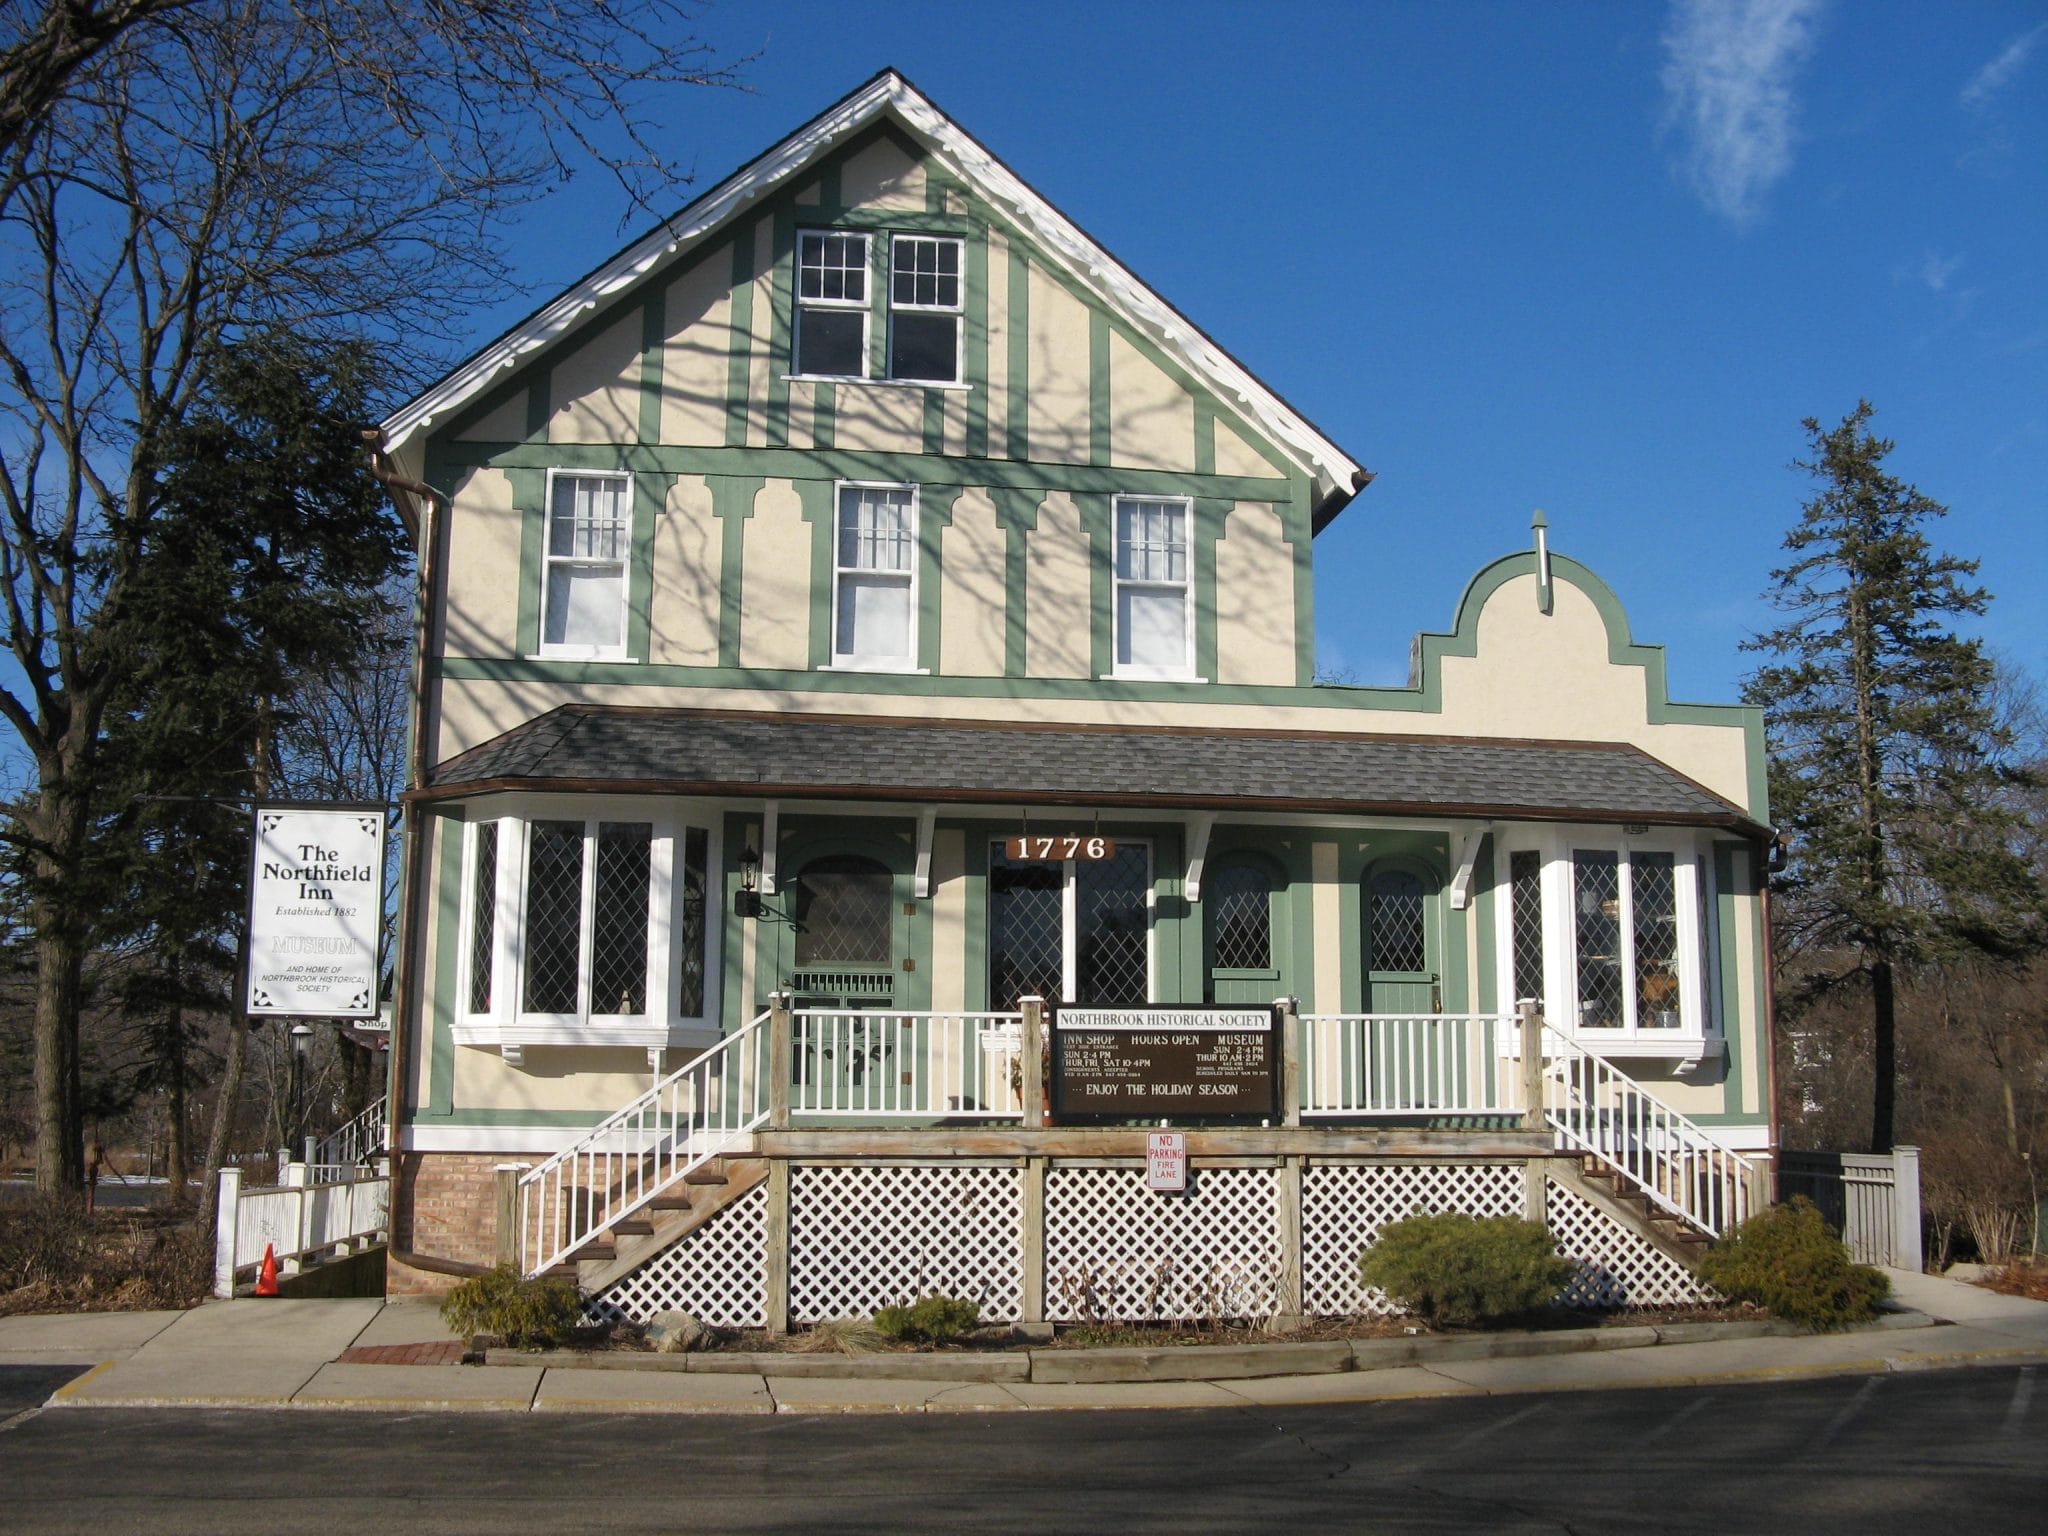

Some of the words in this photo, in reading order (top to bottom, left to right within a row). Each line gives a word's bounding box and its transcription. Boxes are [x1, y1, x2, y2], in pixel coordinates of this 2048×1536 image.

[298, 844, 339, 861] The
[1018, 837, 1105, 859] 1776
[263, 863, 371, 881] Northfield
[299, 883, 334, 900] Inn
[275, 906, 331, 916] Established
[334, 907, 356, 917] 1882
[272, 936, 356, 955] MUSEUM
[261, 974, 318, 983] NORTHBROOK
[319, 975, 366, 984] HISTORICAL
[296, 984, 331, 993] SOCIETY
[1061, 1013, 1144, 1025] NORTHBROOK
[1147, 1014, 1216, 1026] HISTORICAL
[1219, 1015, 1266, 1026] SOCIETY
[1063, 1034, 1082, 1045] INN
[1086, 1034, 1115, 1045] SHOP
[1131, 1035, 1168, 1045] HOURS
[1171, 1034, 1200, 1045] OPEN
[1217, 1034, 1264, 1046] MUSEUM
[1063, 1051, 1080, 1059] SUN
[1099, 1051, 1111, 1059] PM
[1213, 1046, 1230, 1054] SUN
[1252, 1046, 1264, 1054] PM
[1103, 1059, 1120, 1067] SAT
[1196, 1054, 1218, 1062] THUR
[1252, 1054, 1264, 1062] PM
[1086, 1084, 1119, 1095] ENJOY
[1125, 1084, 1147, 1095] THE
[1151, 1084, 1194, 1096] HOLIDAY
[1198, 1084, 1239, 1095] SEASON
[1159, 1135, 1173, 1146] NO
[1149, 1148, 1184, 1160] PARKING
[1157, 1161, 1176, 1169] FIRE
[1155, 1170, 1177, 1179] LANE
